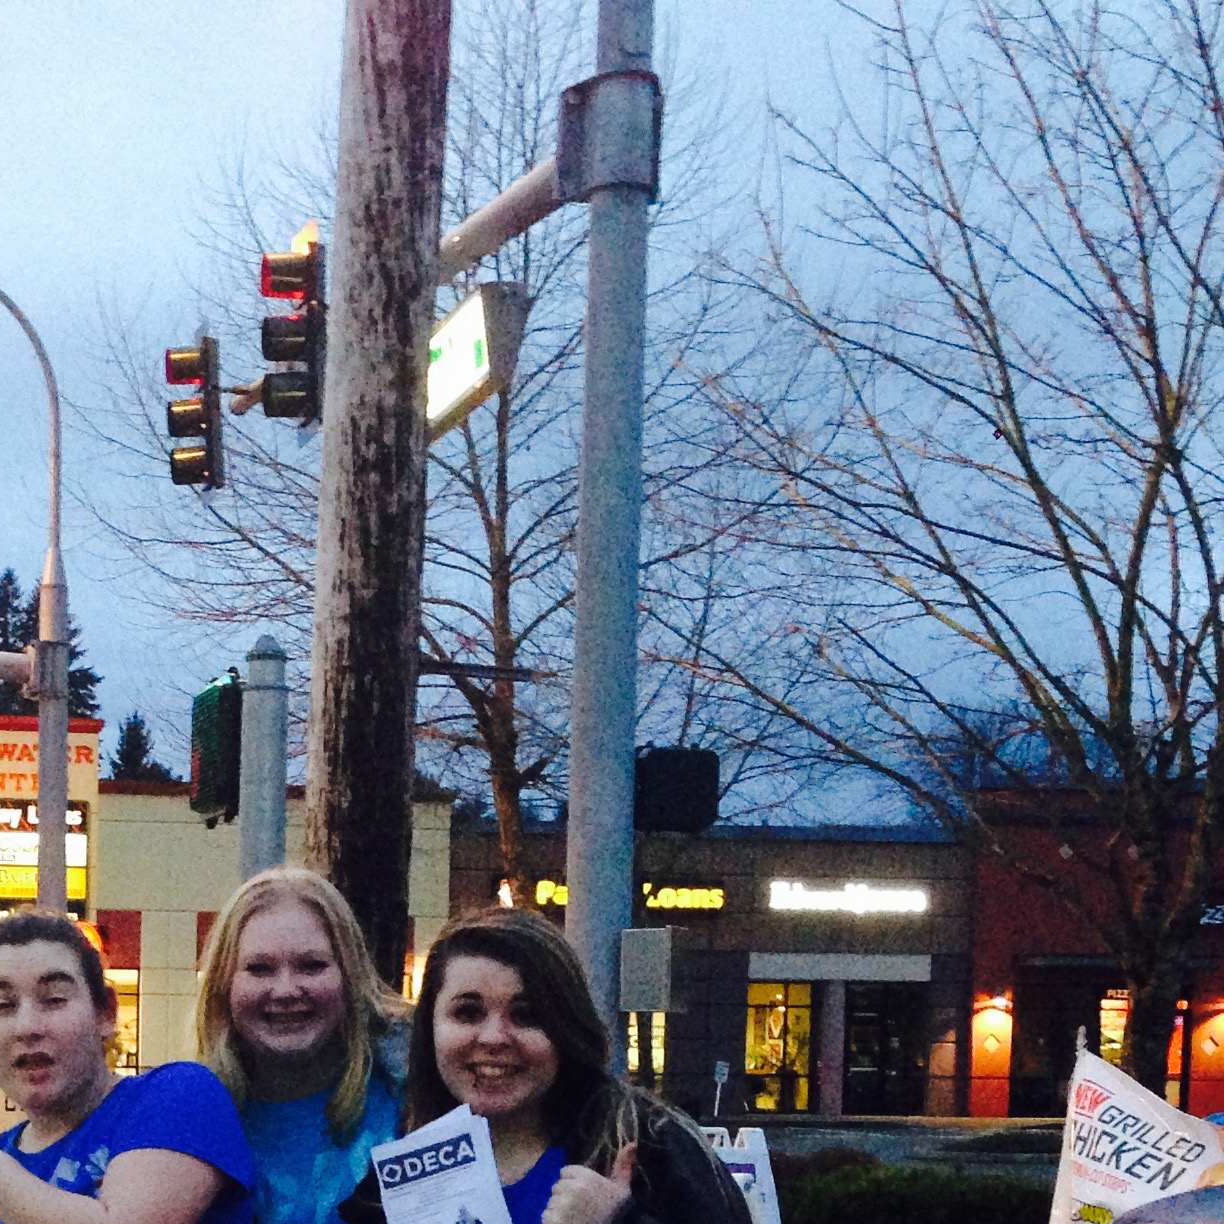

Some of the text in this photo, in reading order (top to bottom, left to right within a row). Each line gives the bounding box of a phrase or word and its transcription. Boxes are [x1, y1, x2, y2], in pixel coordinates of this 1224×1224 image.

[403, 1140, 474, 1178] DECA
[1073, 1121, 1187, 1191] HICKEN
[1098, 1104, 1206, 1163] GRILLED
